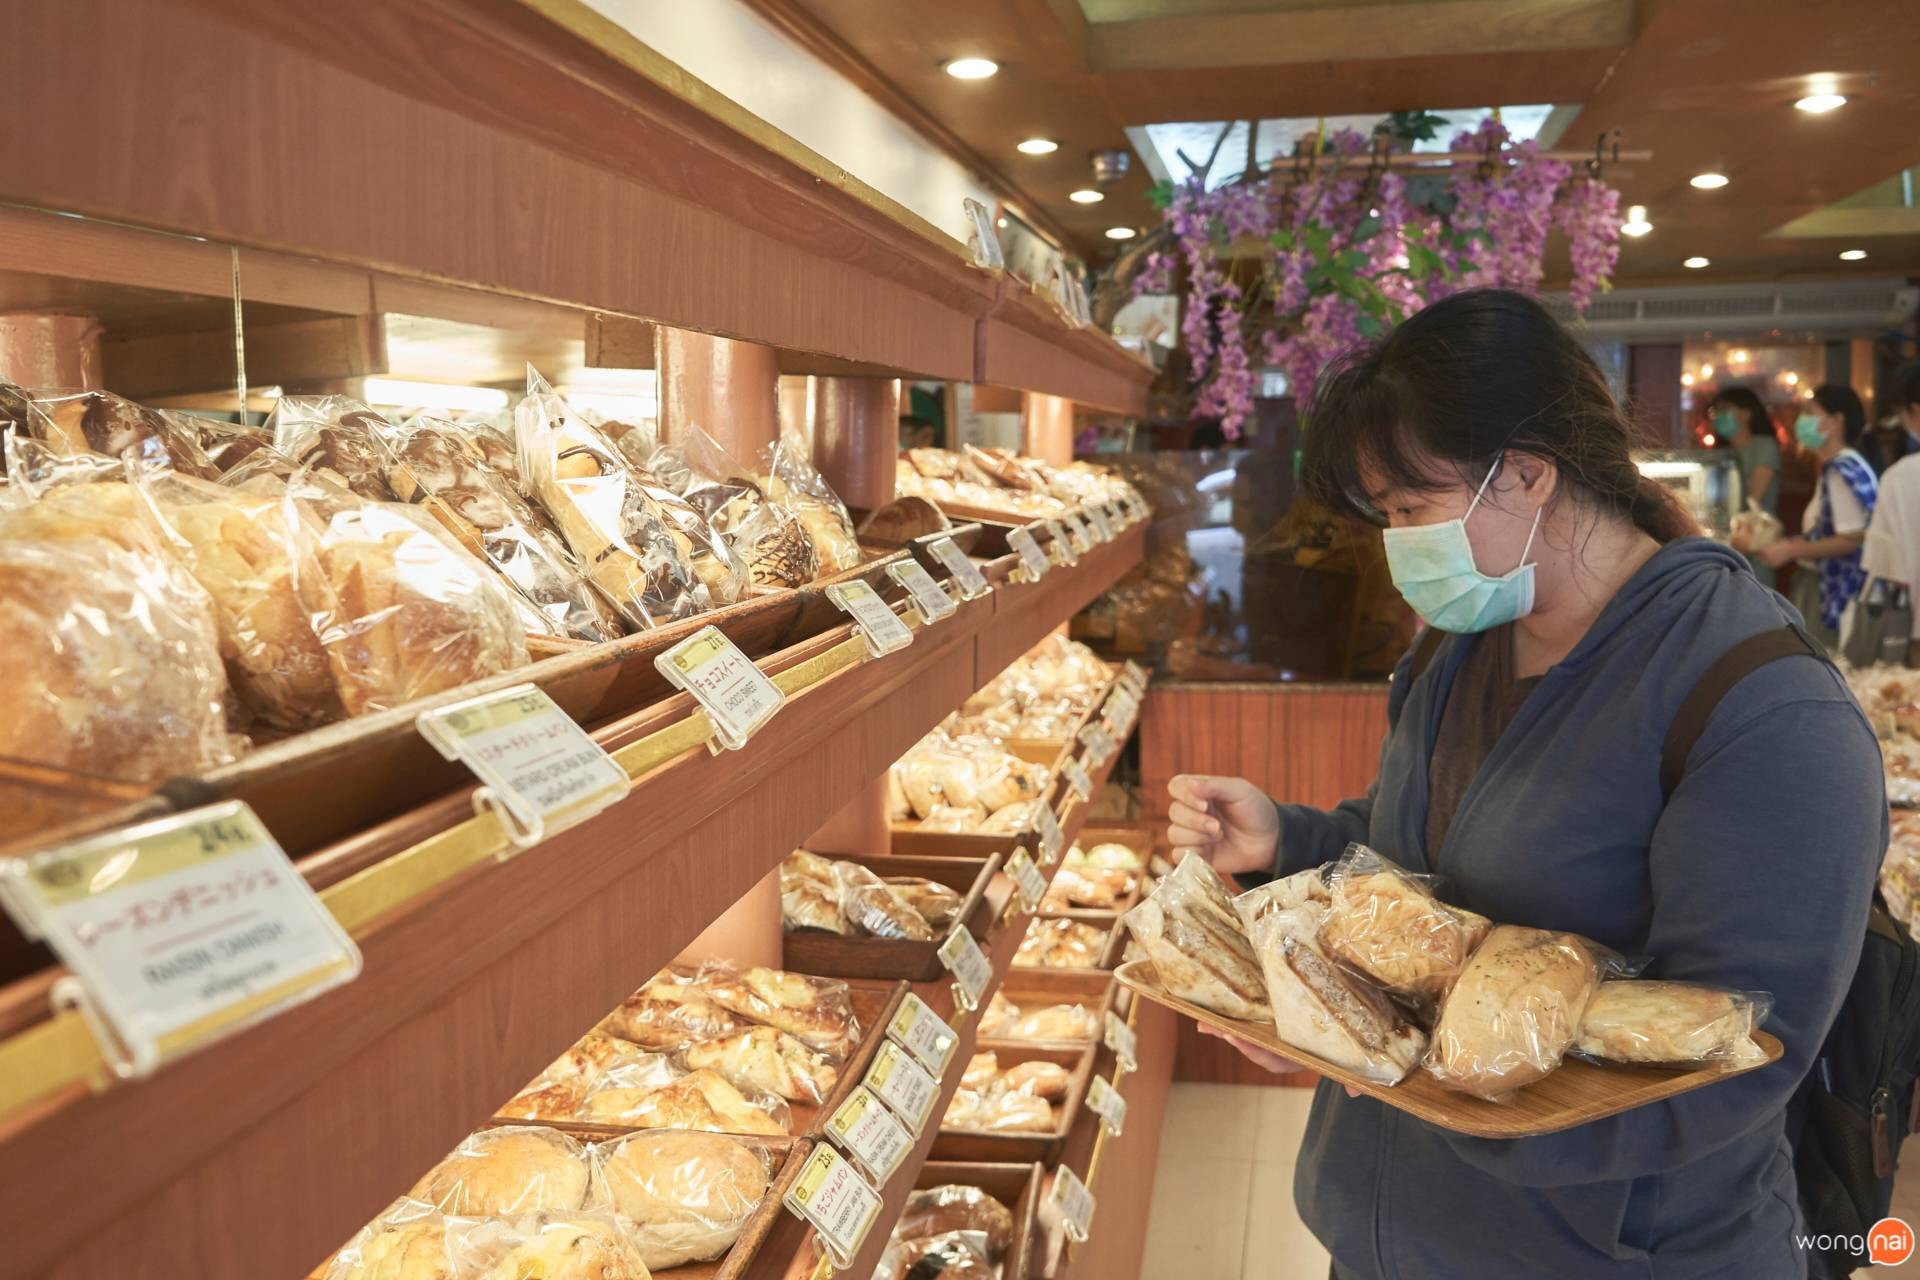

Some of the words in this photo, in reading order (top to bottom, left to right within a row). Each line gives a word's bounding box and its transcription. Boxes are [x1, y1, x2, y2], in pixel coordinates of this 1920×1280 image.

[694, 653, 744, 695] チョコスイート
